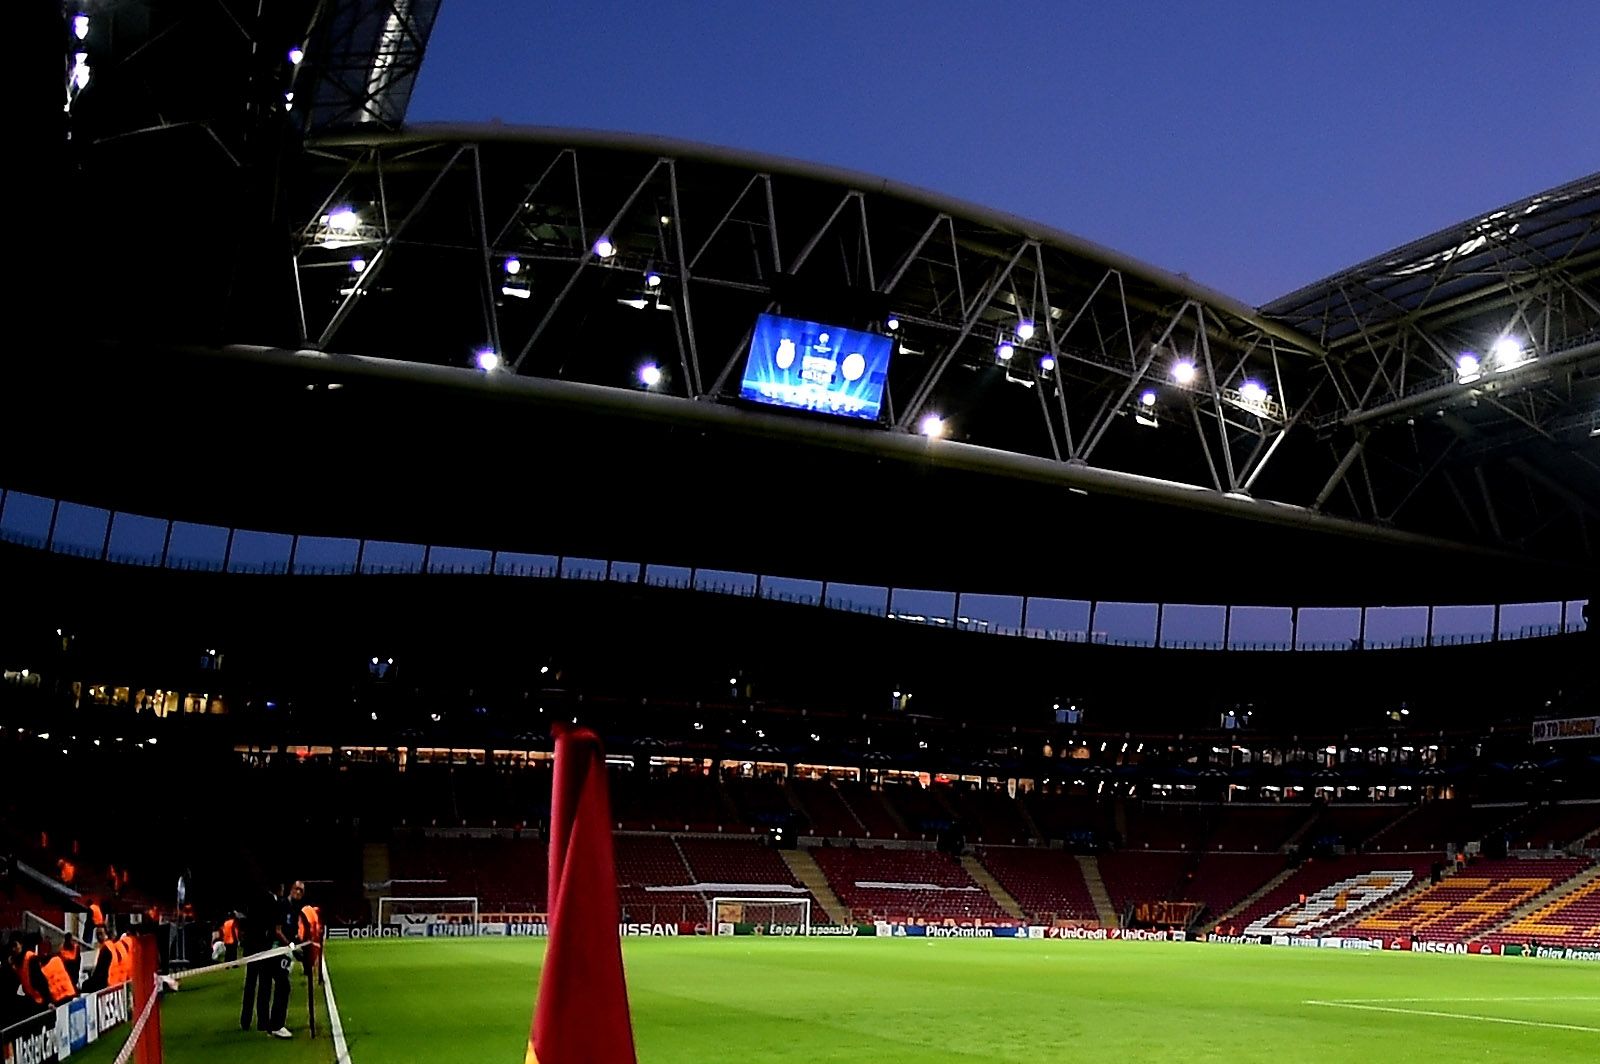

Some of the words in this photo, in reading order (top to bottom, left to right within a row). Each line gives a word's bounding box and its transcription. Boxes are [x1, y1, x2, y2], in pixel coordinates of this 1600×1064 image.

[351, 925, 399, 938] adidas
[800, 923, 858, 937] Rsponsibly
[926, 925, 993, 938] PlayStation
[1060, 927, 1107, 940] UniCredit
[1121, 929, 1168, 941] UniCredit
[1411, 941, 1468, 955] NISSAN
[1536, 945, 1564, 961] Enjoy
